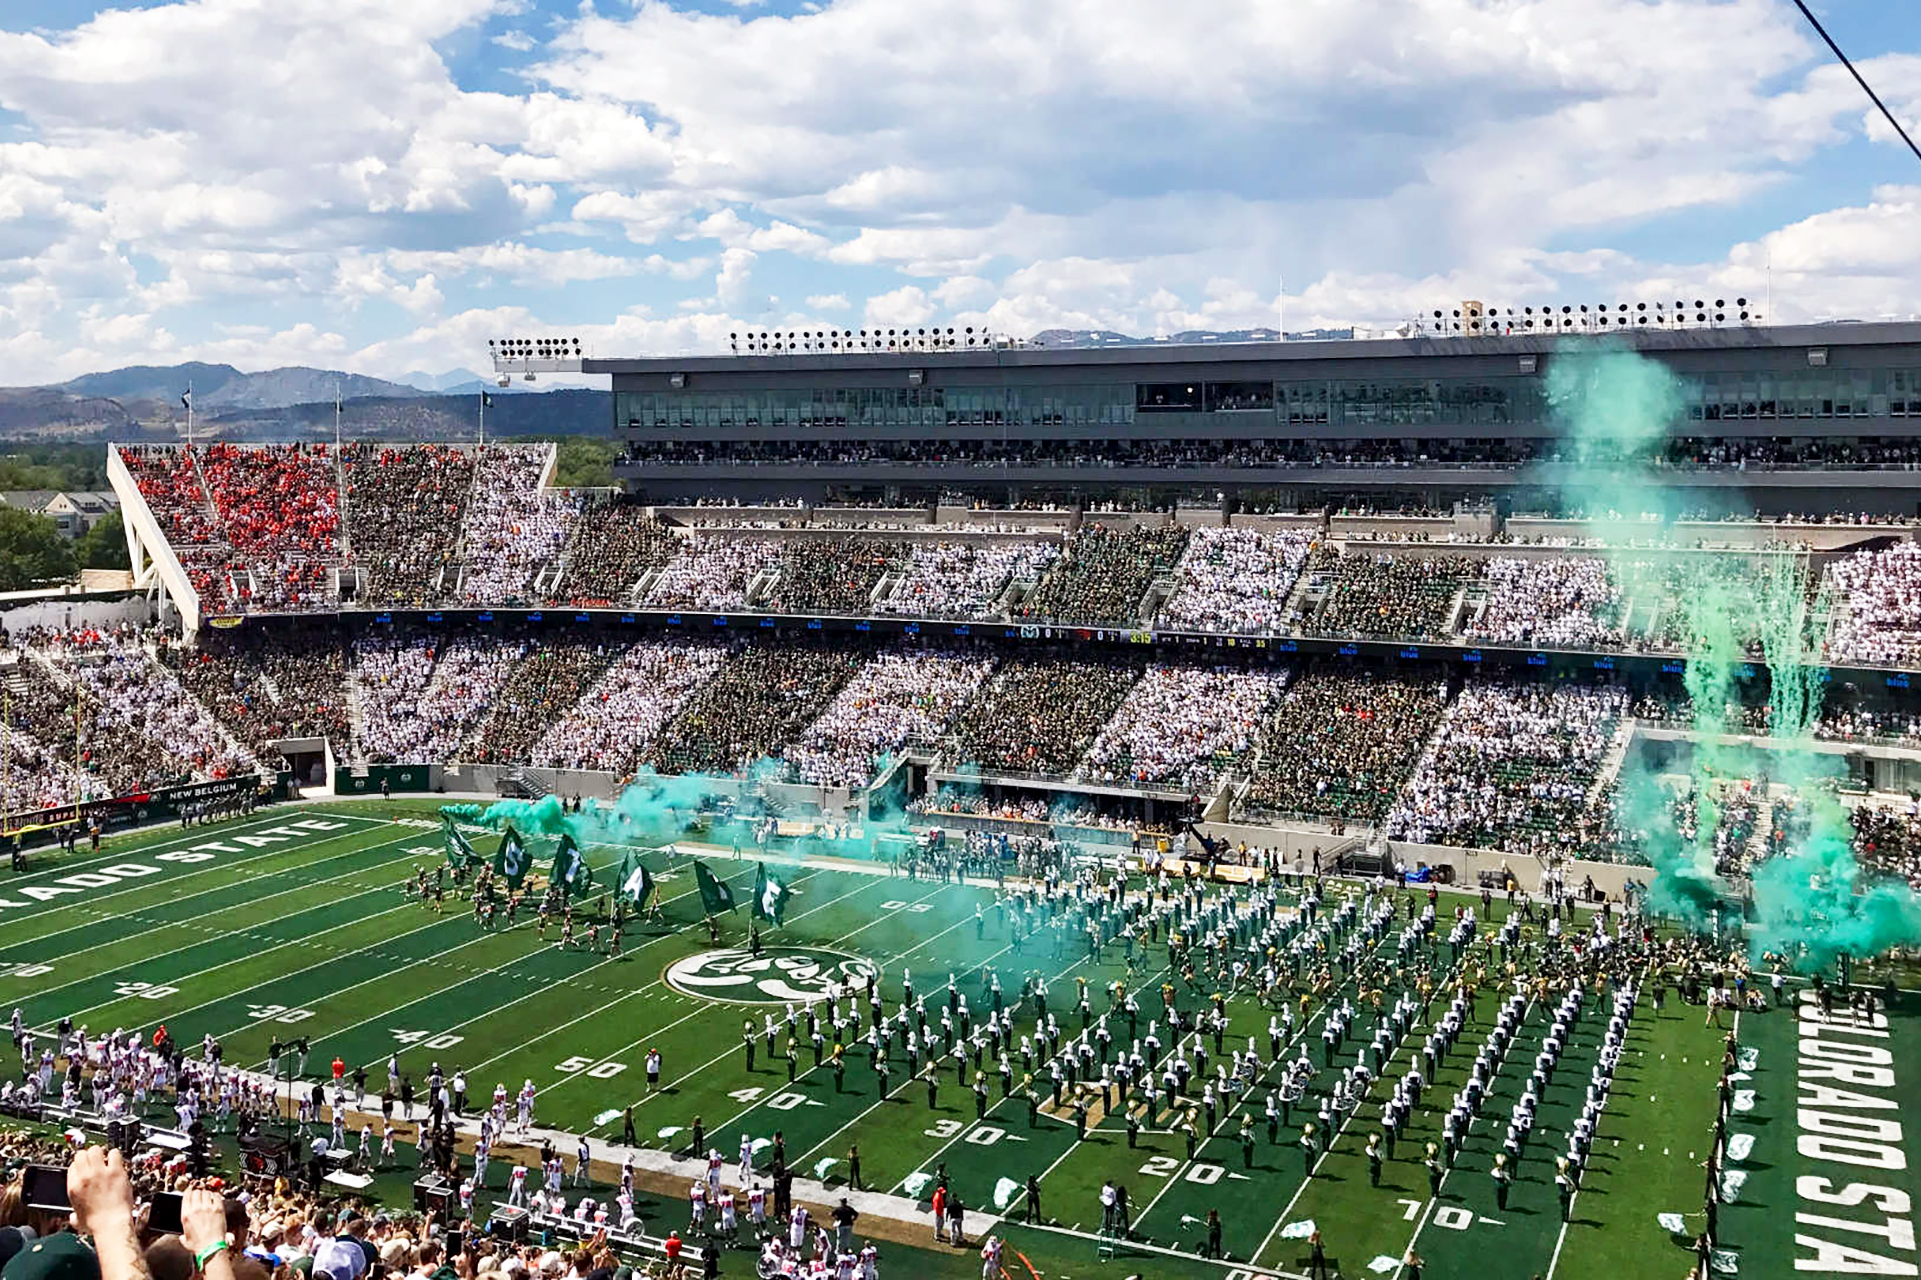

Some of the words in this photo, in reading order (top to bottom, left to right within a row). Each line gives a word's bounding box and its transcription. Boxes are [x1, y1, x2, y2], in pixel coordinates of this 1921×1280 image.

[1097, 630, 1104, 641] 0
[1130, 631, 1151, 644] 3:15
[169, 789, 192, 800] NEW
[195, 782, 238, 796] BELGIUM
[155, 819, 349, 863] STATE
[112, 981, 180, 999] 20
[247, 1004, 316, 1023] 30
[391, 1030, 465, 1049] 40
[554, 1056, 628, 1078] 50
[727, 1087, 808, 1110] 40
[924, 1119, 1006, 1146] 30
[1138, 1156, 1226, 1185] 20
[1397, 1199, 1474, 1230] 10
